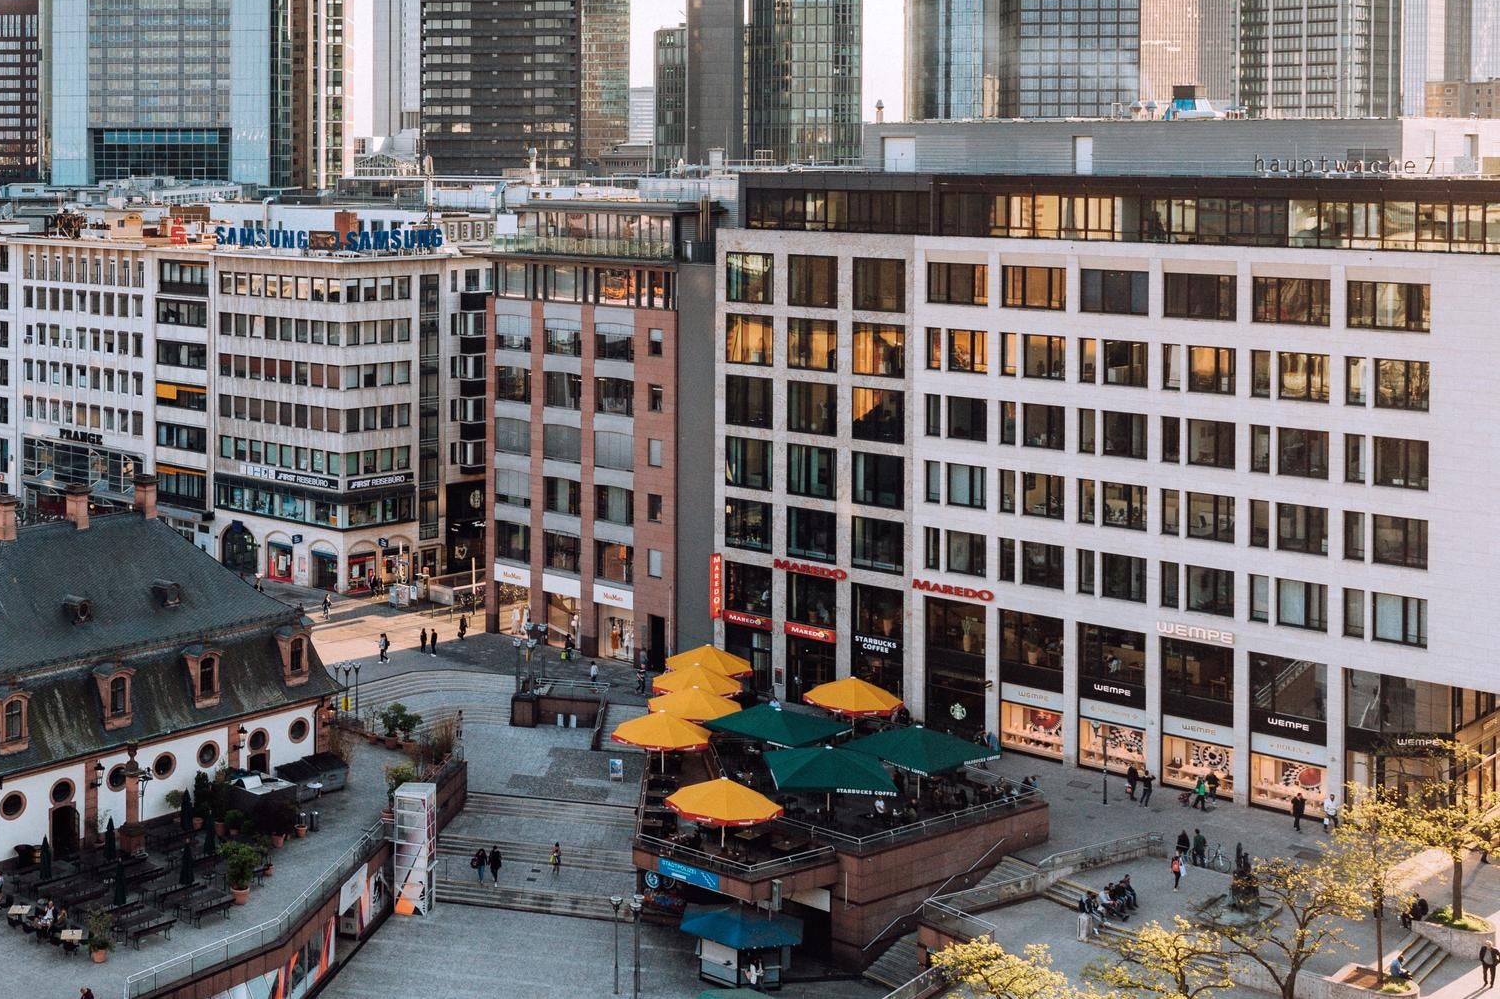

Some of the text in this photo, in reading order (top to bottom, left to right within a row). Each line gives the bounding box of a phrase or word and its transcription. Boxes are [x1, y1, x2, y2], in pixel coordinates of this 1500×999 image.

[1254, 154, 1436, 177] hauptwache 7
[216, 227, 308, 249] SAMSUNG
[346, 228, 443, 250] SAMSUNG
[773, 558, 847, 581] MAREDO
[912, 579, 995, 602] MAREDO
[728, 614, 762, 626] MAREDO
[791, 626, 825, 639] MAREDO
[1156, 620, 1235, 645] WEMPE
[855, 635, 897, 649] STARBUCKS
[862, 642, 889, 654] COFFEE
[1018, 690, 1049, 701] WEMPE
[1093, 683, 1131, 697] WEMPE
[1182, 723, 1217, 736] WEMPE
[1267, 717, 1310, 732] WEMPE
[1397, 738, 1441, 747] WEMPE
[836, 788, 873, 796] STARBUCKS
